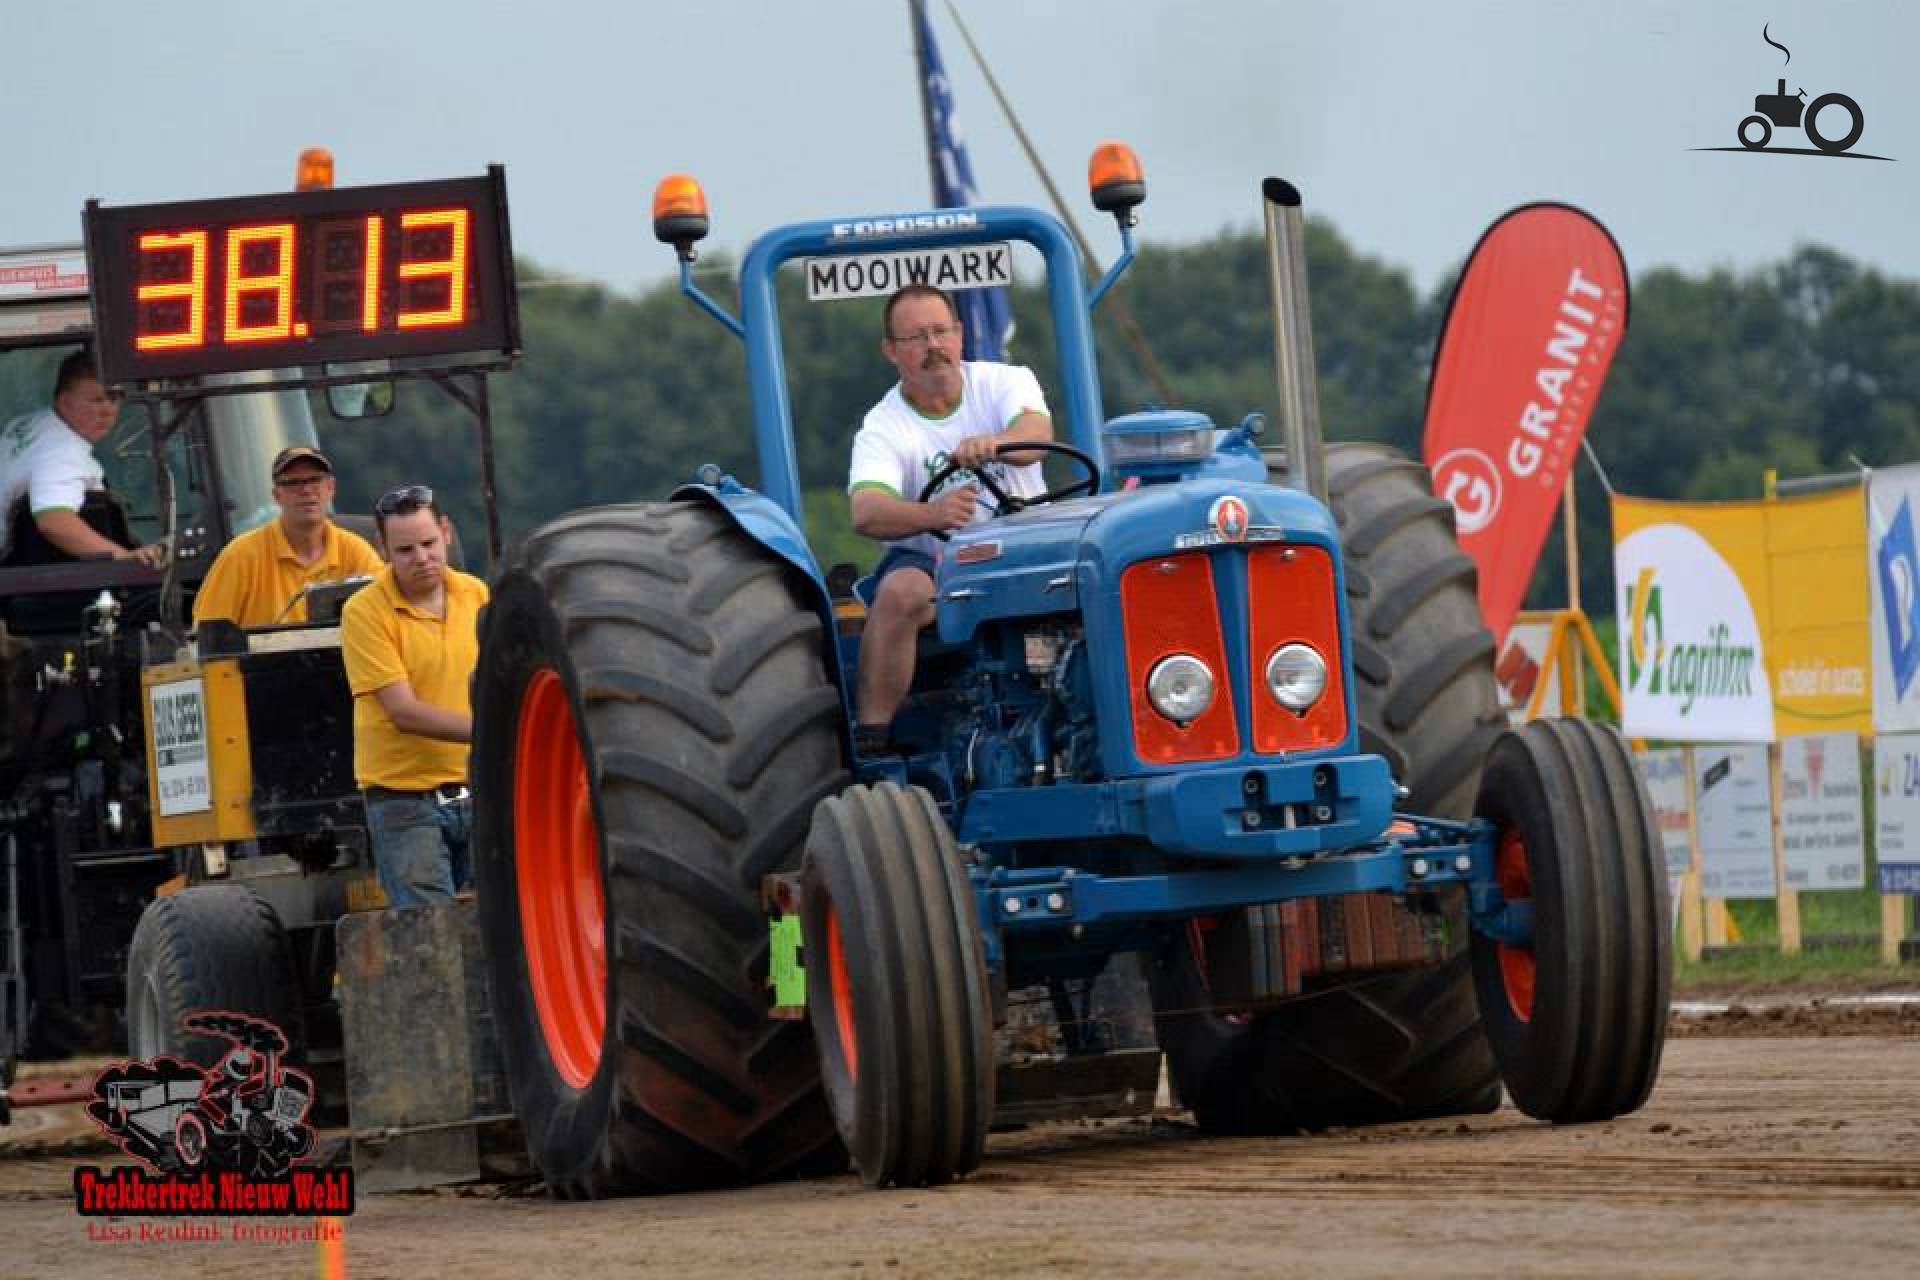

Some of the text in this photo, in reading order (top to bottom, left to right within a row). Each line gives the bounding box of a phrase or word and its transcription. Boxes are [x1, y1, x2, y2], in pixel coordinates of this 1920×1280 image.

[832, 212, 978, 238] FORDSON
[811, 249, 1007, 294] MOOIWARK
[1507, 267, 1602, 478] GRANIT
